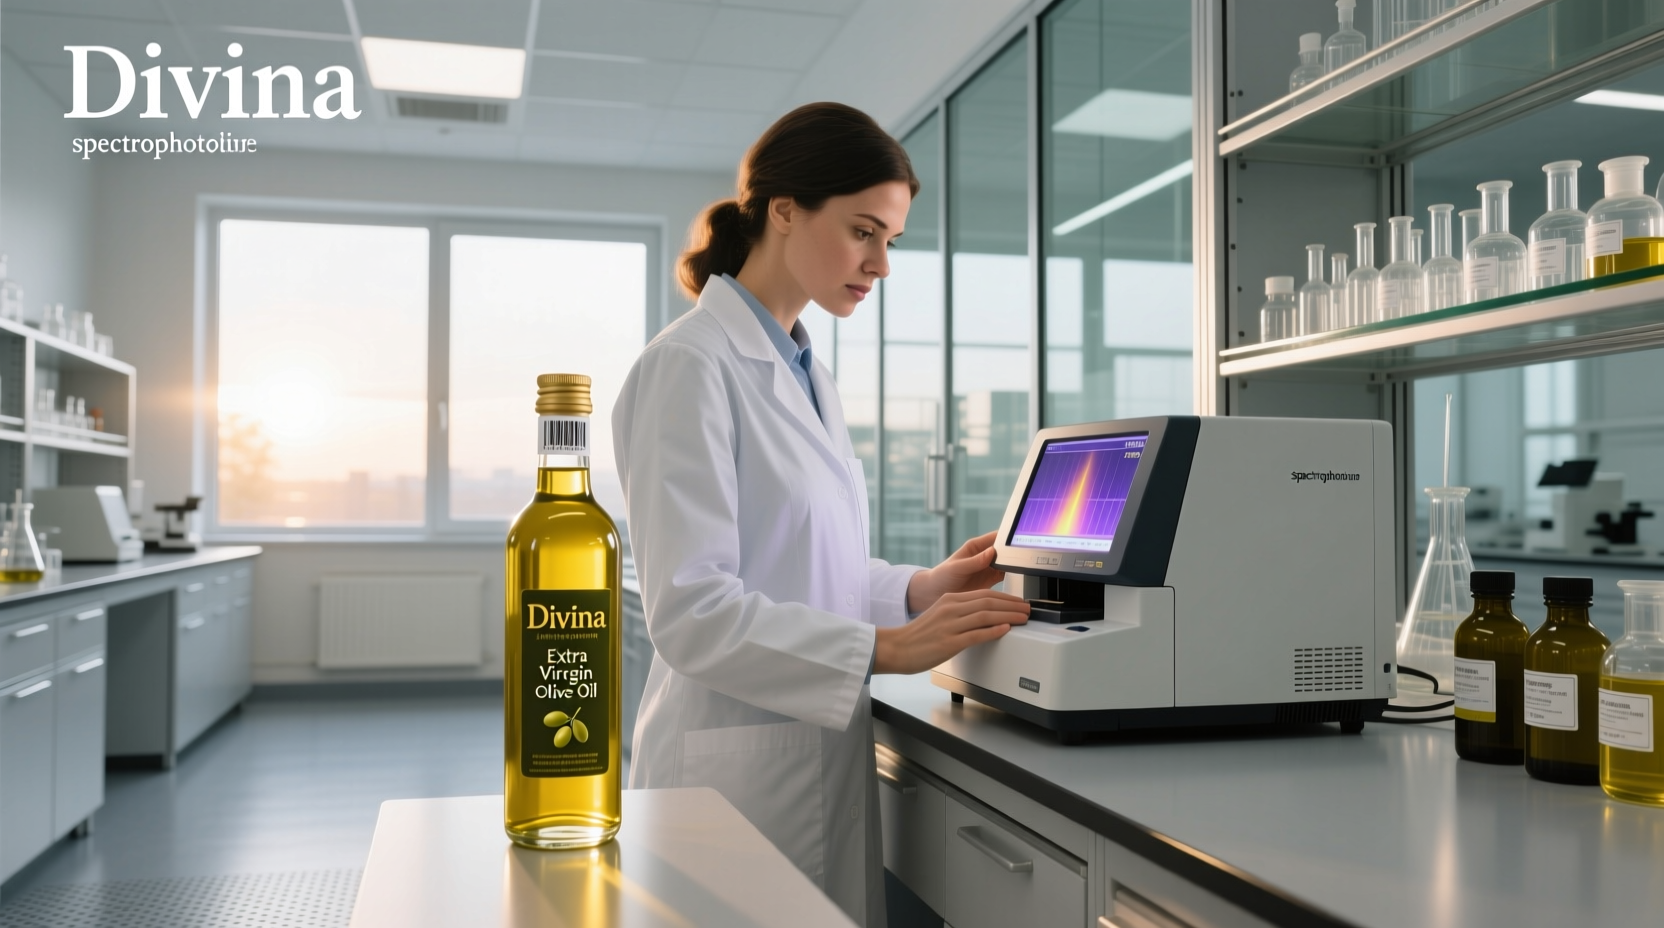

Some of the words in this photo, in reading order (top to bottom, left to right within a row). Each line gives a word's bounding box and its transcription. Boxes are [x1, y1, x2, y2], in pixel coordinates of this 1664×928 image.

[527, 604, 606, 630] Divina
[547, 648, 588, 665] Extra
[535, 684, 573, 699] Olive
